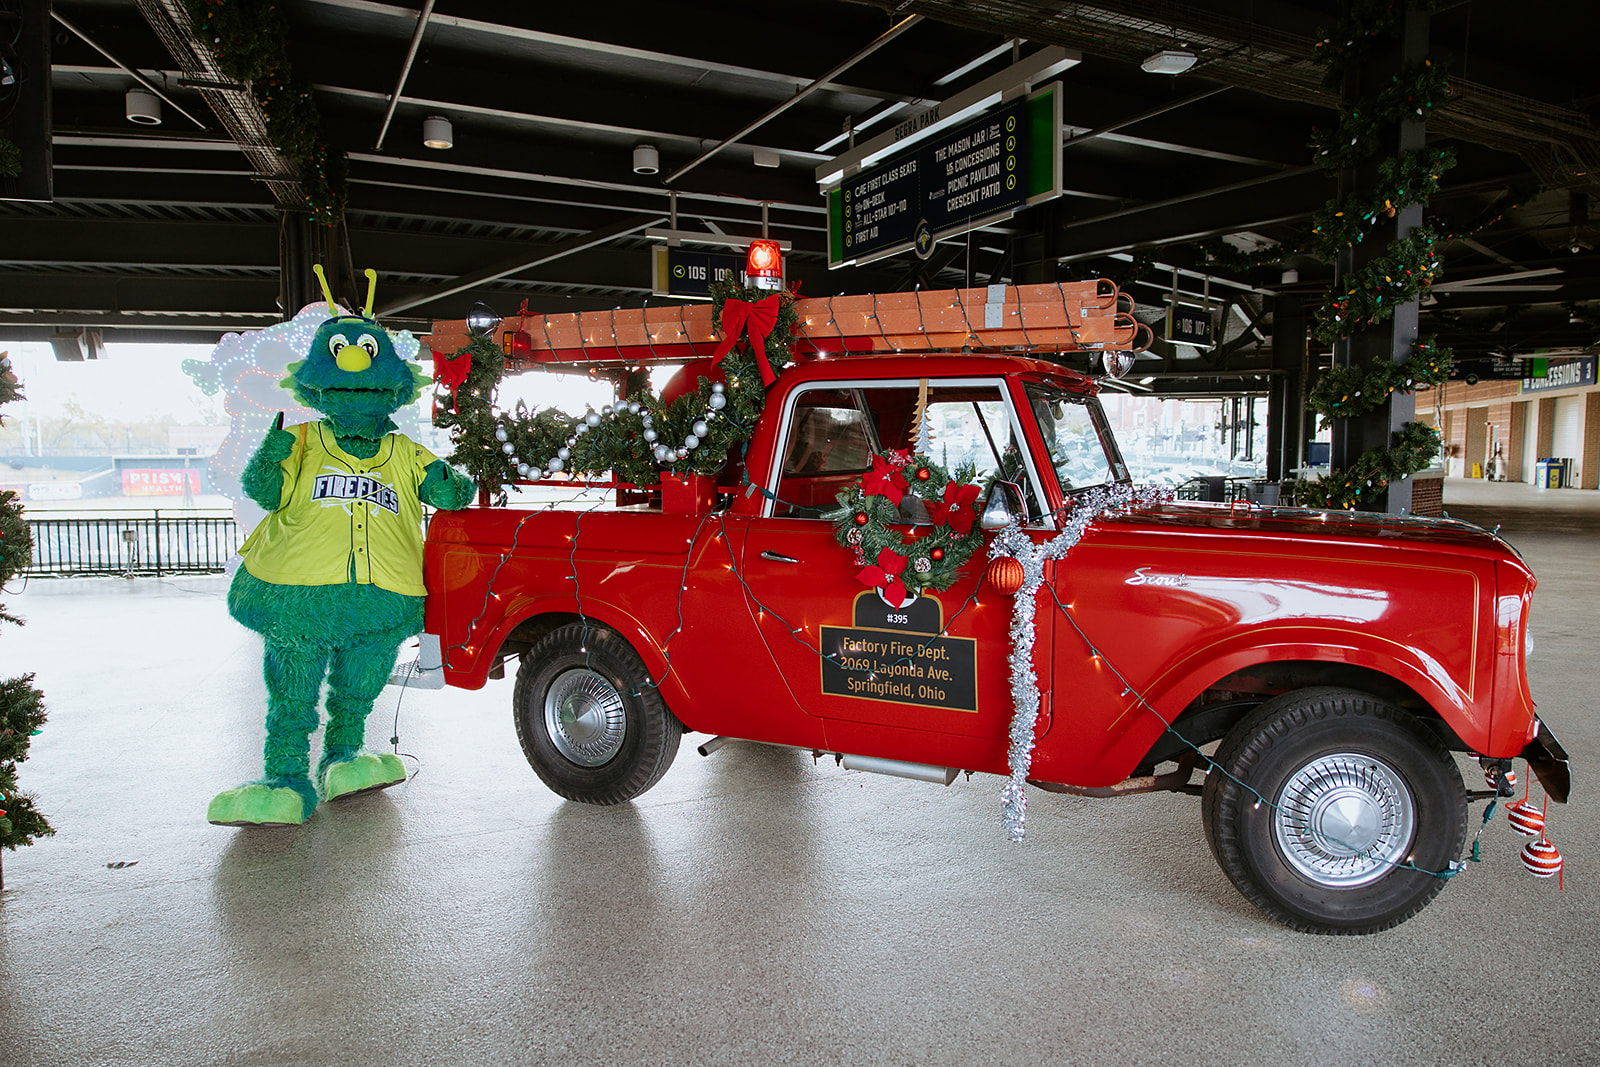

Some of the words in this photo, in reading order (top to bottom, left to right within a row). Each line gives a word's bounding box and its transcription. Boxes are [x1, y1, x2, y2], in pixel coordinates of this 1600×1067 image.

[894, 118, 918, 141] SEGRA
[920, 105, 940, 129] PARK
[935, 146, 947, 163] THE
[948, 136, 971, 158] MASON
[972, 129, 985, 147] JAR
[955, 142, 1000, 173] CONCESSIONS
[867, 176, 881, 192] FIRST
[882, 168, 899, 186] CLASS
[899, 160, 917, 178] SEATS
[947, 174, 969, 194] PICNIC
[970, 161, 1000, 185] PAVILION
[862, 191, 886, 210] ON-DECK
[947, 188, 980, 212] CRESCENT
[981, 181, 1001, 200] PATIO
[863, 206, 887, 226] ALL-STAR
[888, 198, 907, 217] 107-110
[855, 229, 869, 245] FIRST
[870, 226, 879, 240] AID
[687, 265, 707, 281] 105
[713, 267, 727, 282] 10
[1182, 318, 1193, 334] 106
[1195, 320, 1205, 335] 107
[1585, 362, 1592, 380] 3
[141, 485, 182, 493] HEALTH
[313, 475, 399, 514] FIREFLIES
[1124, 566, 1190, 587] Scout
[886, 613, 908, 625] #395
[843, 637, 888, 657] Factory
[890, 641, 914, 657] Fire
[917, 643, 950, 662] Dept.
[840, 656, 870, 671] 2069
[873, 659, 924, 678] Lagonda
[927, 665, 953, 682] Ave.
[847, 677, 915, 699] Springfield,
[918, 684, 946, 701] Ohio
